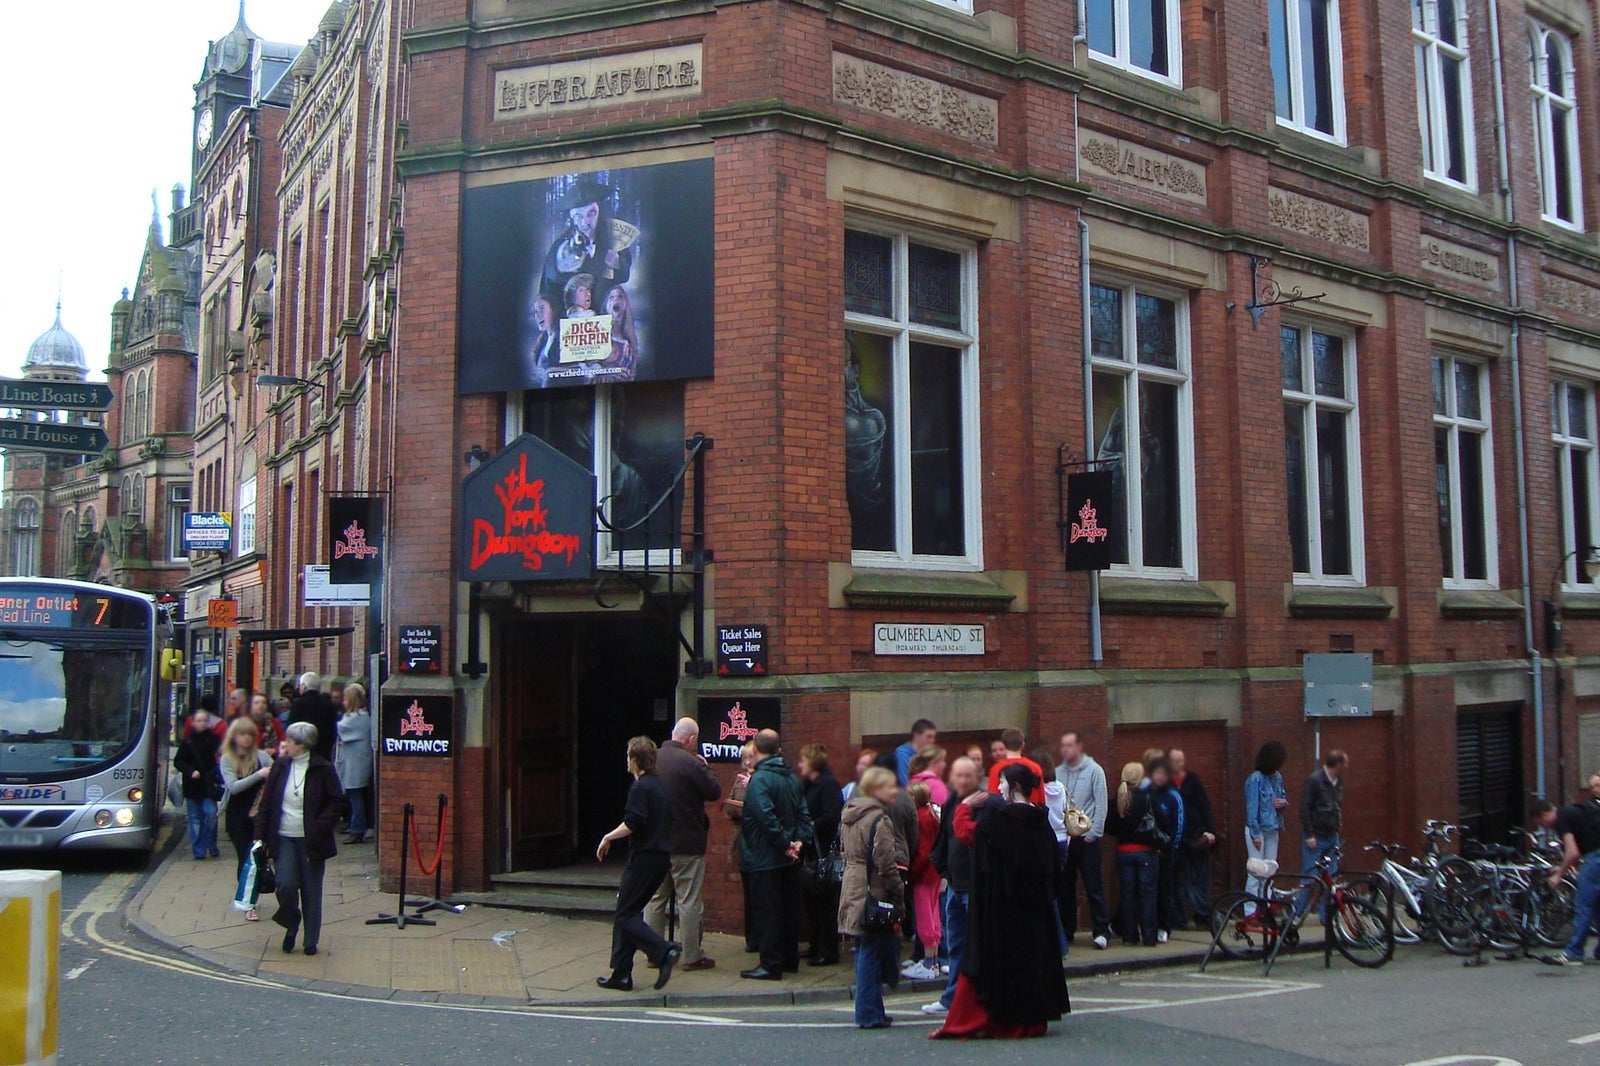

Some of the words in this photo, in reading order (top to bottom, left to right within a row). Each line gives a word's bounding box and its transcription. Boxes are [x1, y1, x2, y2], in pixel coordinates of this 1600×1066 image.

[1119, 149, 1169, 186] ART
[571, 321, 600, 335] DICK
[563, 332, 609, 347] TURPIN
[549, 367, 622, 378] www.thedungeons.com
[3, 385, 39, 401] Line
[41, 387, 86, 404] Boats
[1, 428, 17, 439] ra
[22, 424, 78, 444] House
[504, 453, 544, 504] the
[494, 483, 548, 536] York
[191, 514, 225, 525] Blacks
[1070, 523, 1107, 543] Dungeon
[335, 541, 378, 559] Dungeon
[470, 517, 580, 570] Dungeon
[36, 597, 79, 610] Outlet
[23, 610, 50, 623] Line
[94, 598, 109, 625] 7
[721, 629, 742, 640] Ticket
[744, 628, 762, 639] Sales
[878, 628, 961, 642] CUMBERLAND
[721, 642, 743, 655] Queue
[745, 642, 761, 652] Here
[400, 718, 434, 736] Dungeon
[720, 721, 758, 741] Dungeon
[385, 738, 449, 753] ENTRANCE
[113, 769, 145, 780] 69373
[13, 788, 53, 799] RIDE
